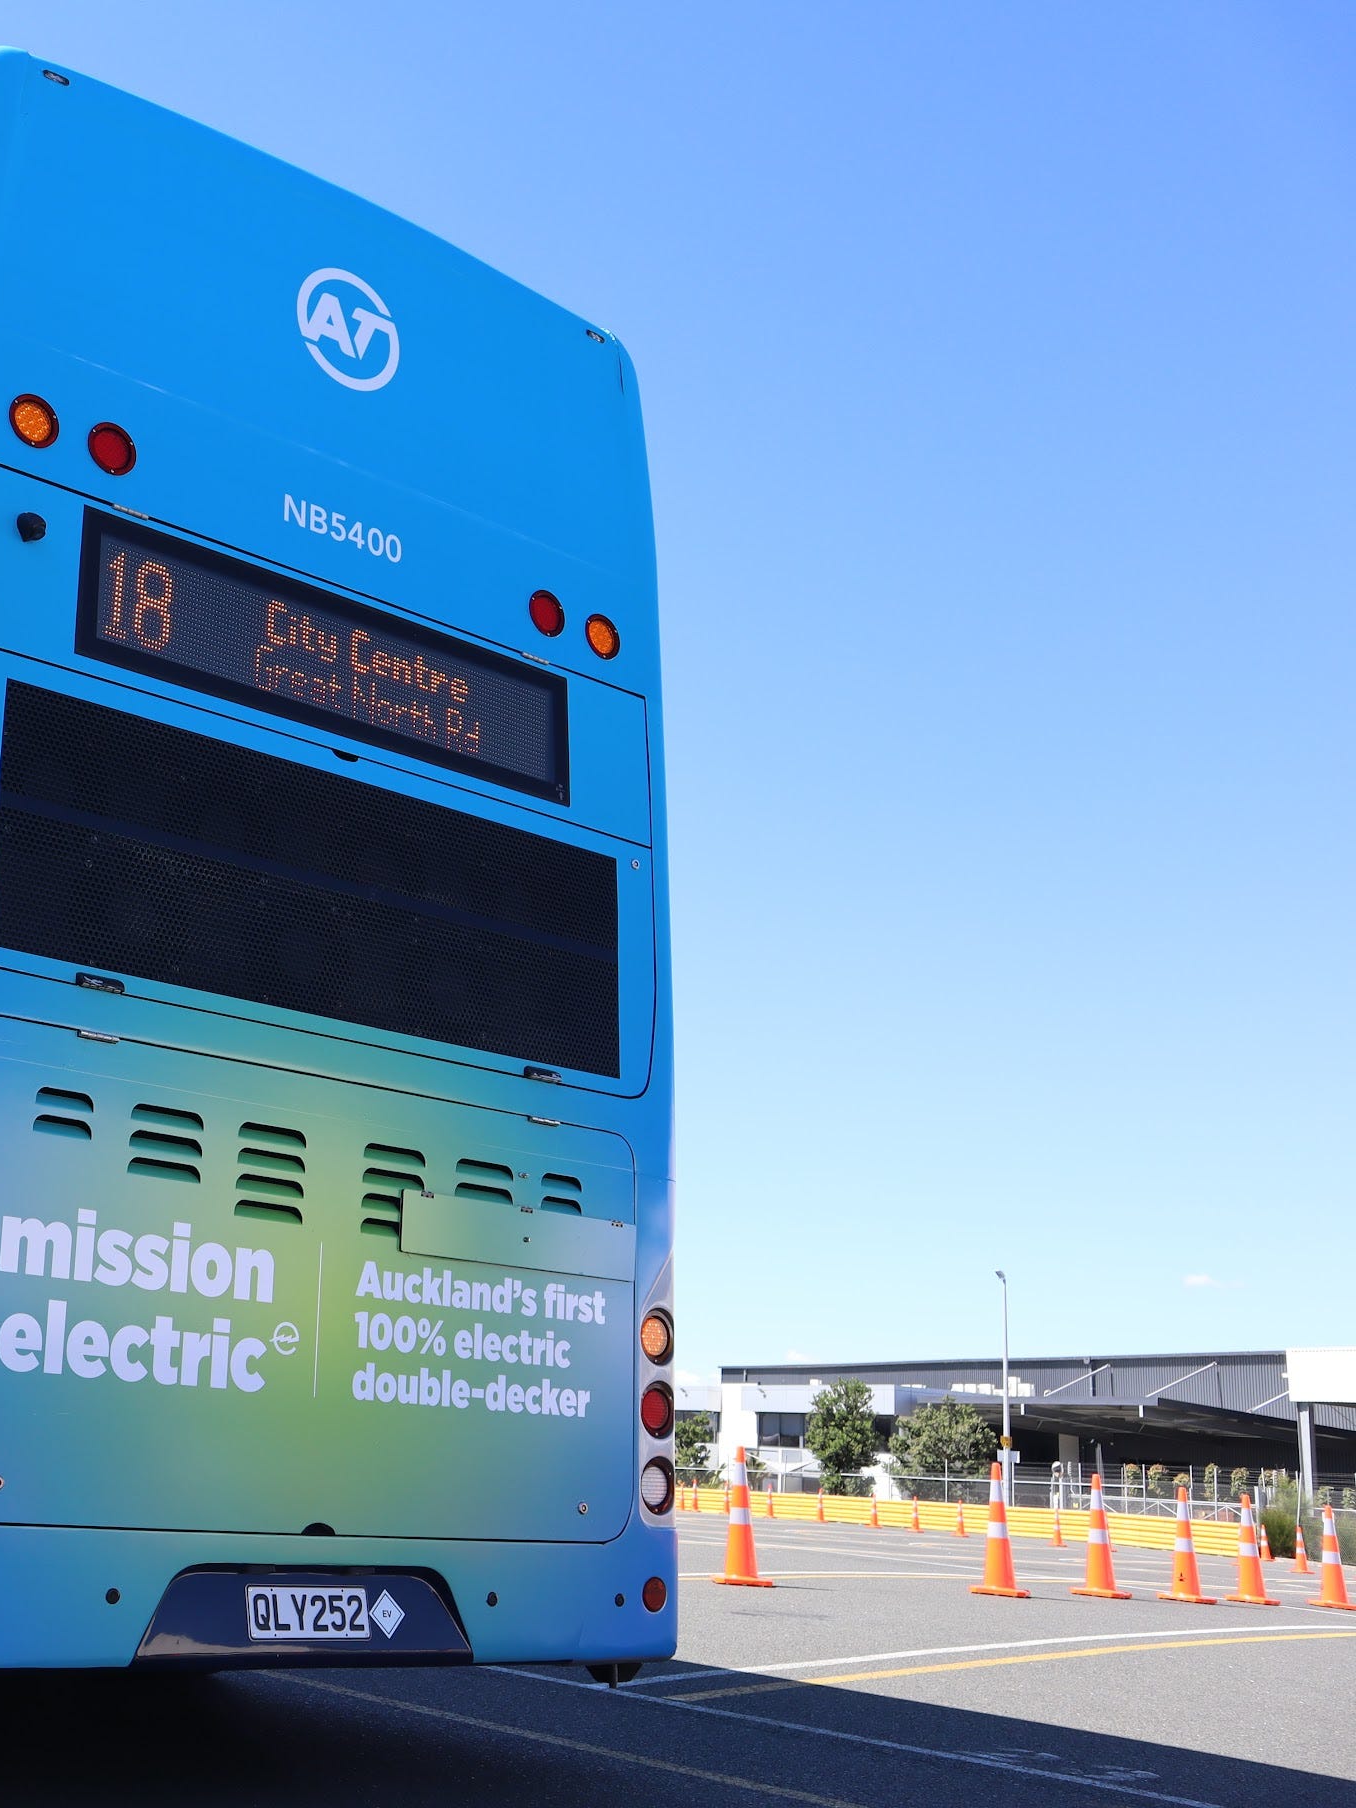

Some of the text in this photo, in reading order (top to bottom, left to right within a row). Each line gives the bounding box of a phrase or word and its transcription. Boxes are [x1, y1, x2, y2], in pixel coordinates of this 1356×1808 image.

[283, 493, 403, 563] NB5400
[104, 551, 174, 652] 18
[266, 600, 470, 702] City Centre
[254, 646, 481, 753] Great North Rd
[0, 1208, 274, 1303] mission
[543, 1282, 606, 1325] first
[354, 1312, 571, 1368] 100% electric
[352, 1362, 591, 1418] double-decker
[253, 1594, 365, 1632] QLY252
[382, 1610, 392, 1618] EV
